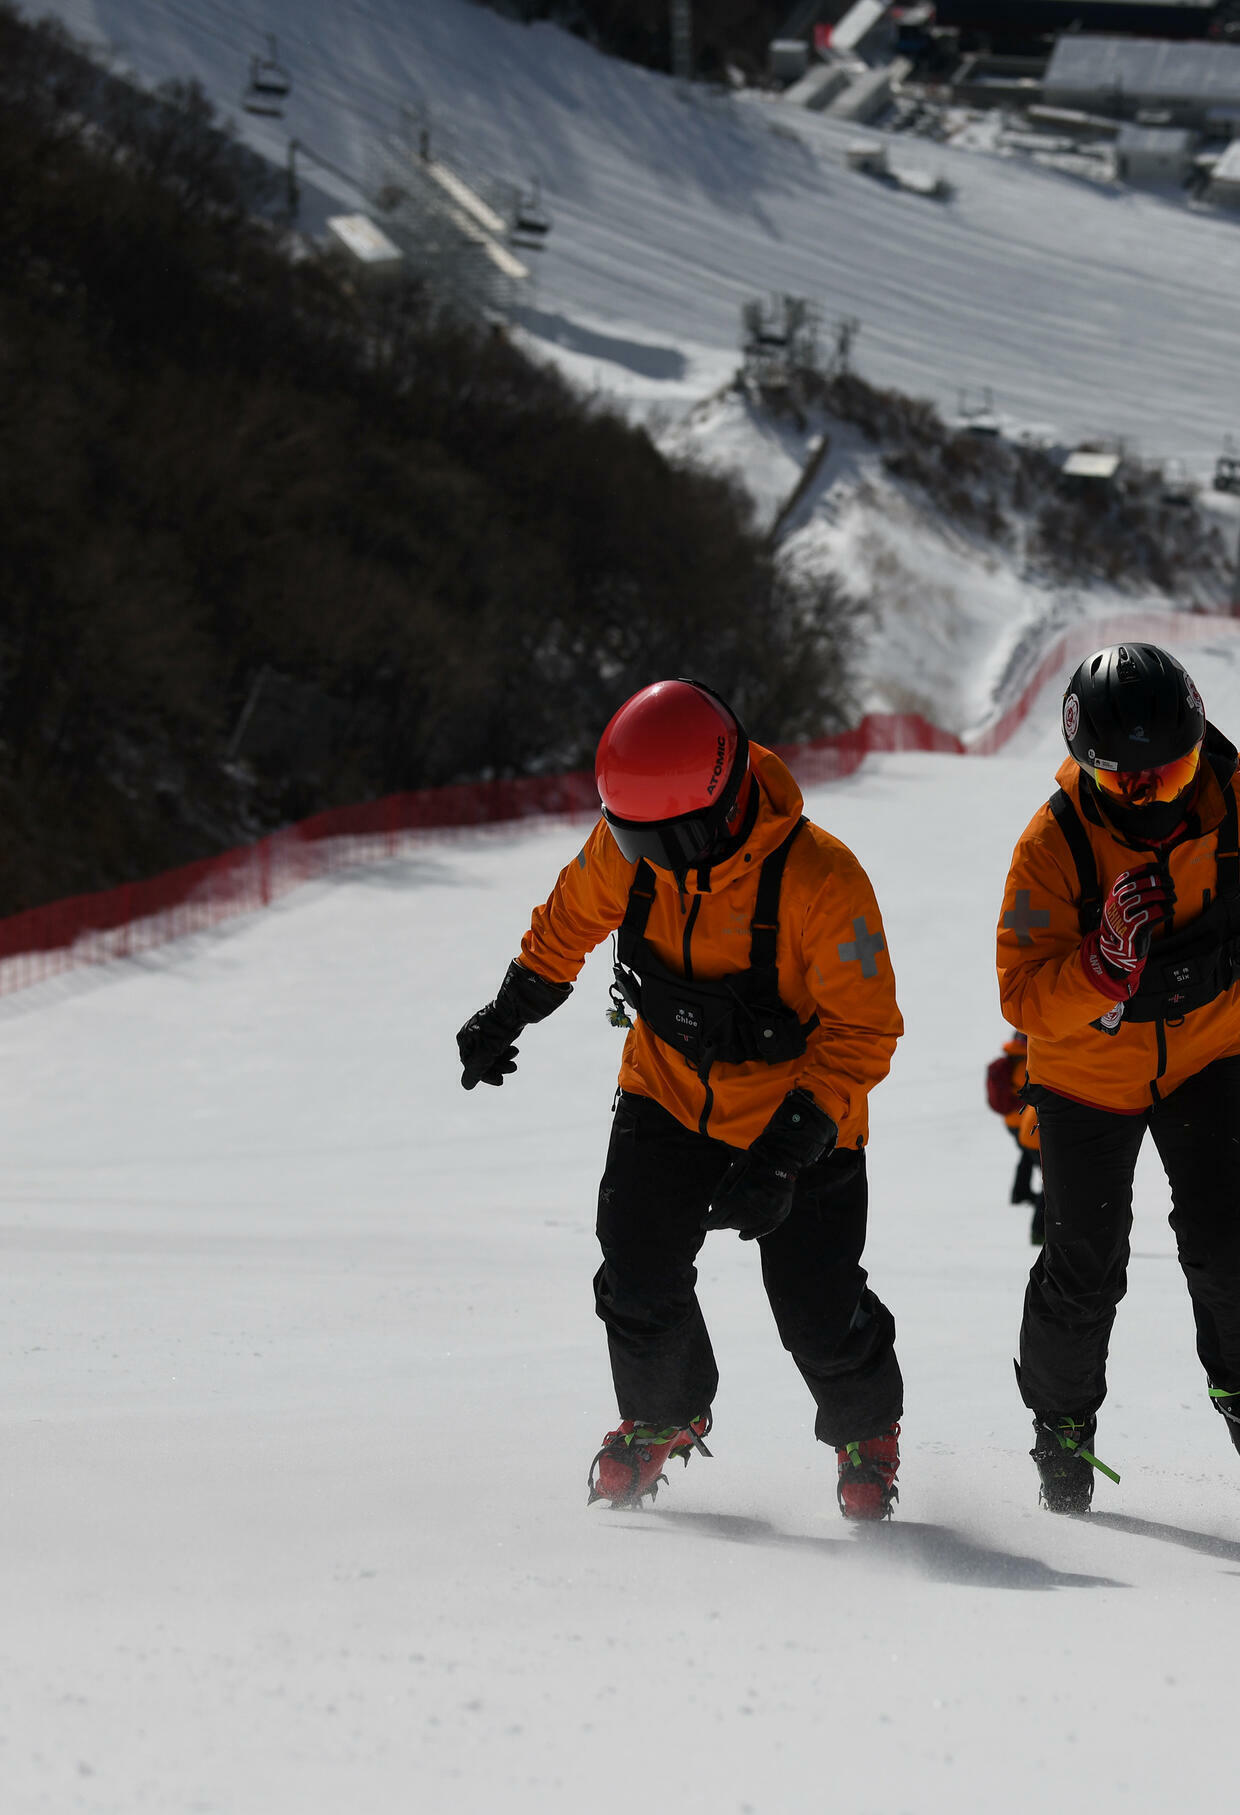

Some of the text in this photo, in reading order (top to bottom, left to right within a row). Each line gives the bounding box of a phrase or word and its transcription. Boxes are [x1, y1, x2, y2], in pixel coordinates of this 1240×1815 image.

[707, 736, 725, 795] ATOMIC
[1107, 902, 1128, 937] CHINA
[1089, 954, 1104, 976] ANTA
[1176, 973, 1190, 982] Six
[675, 1014, 698, 1027] Chloe
